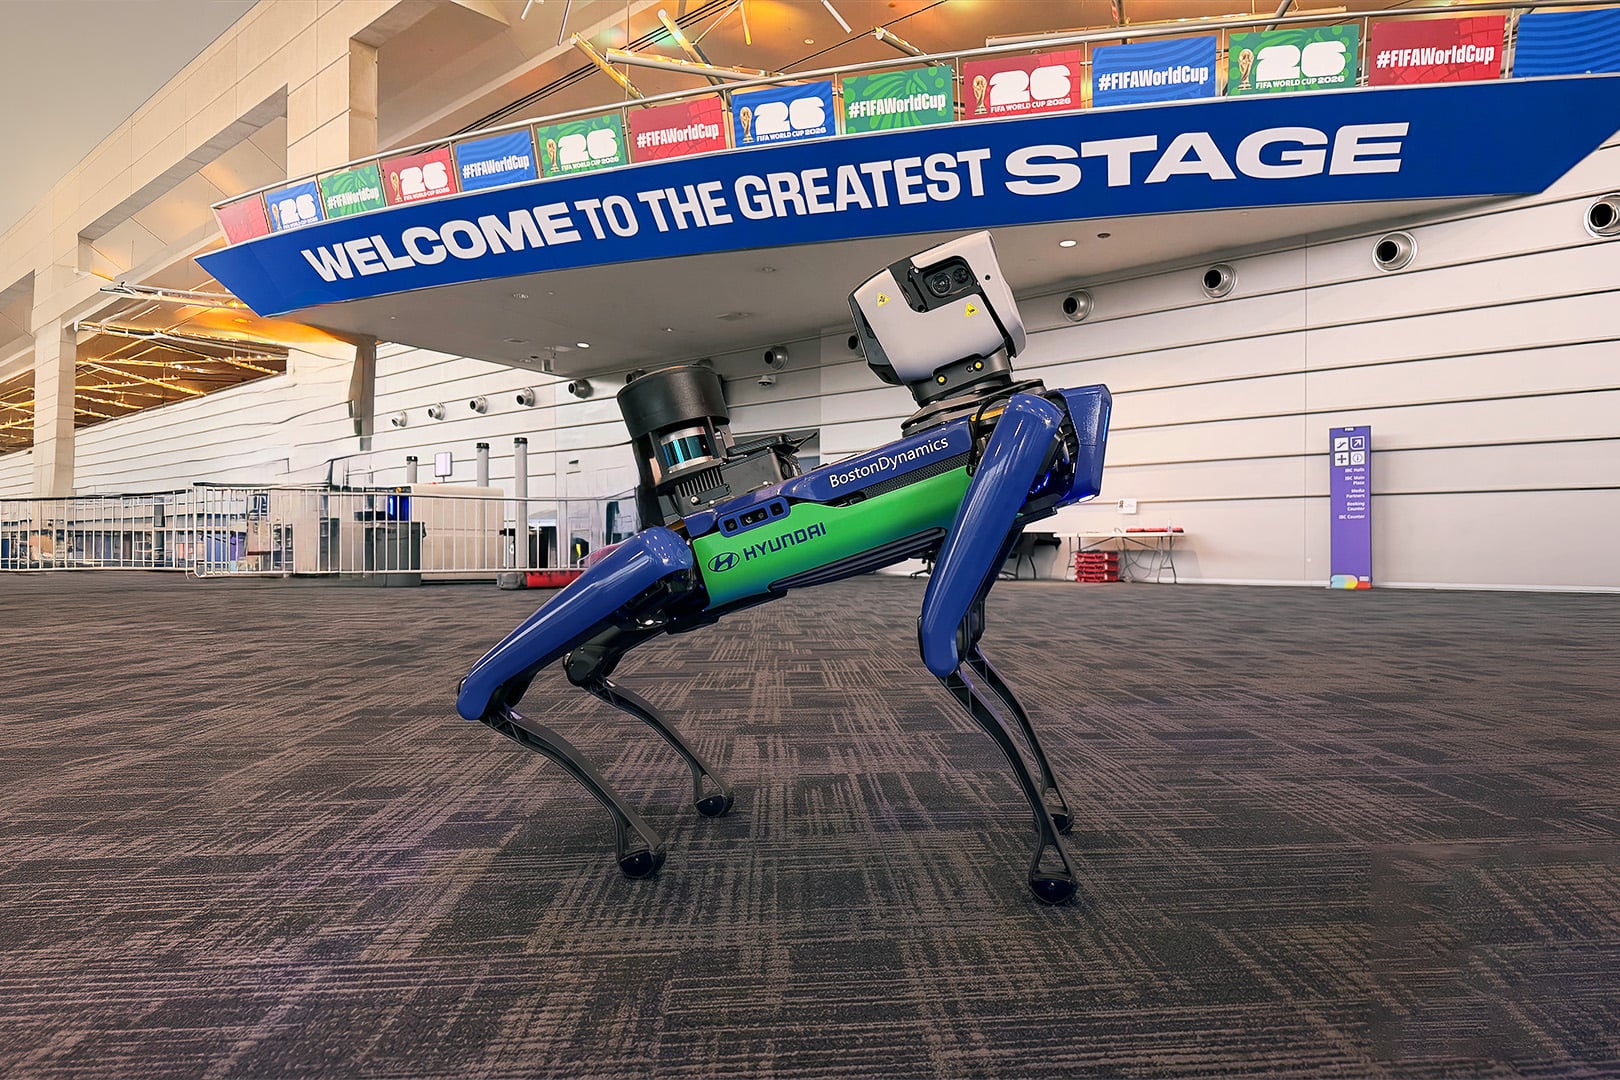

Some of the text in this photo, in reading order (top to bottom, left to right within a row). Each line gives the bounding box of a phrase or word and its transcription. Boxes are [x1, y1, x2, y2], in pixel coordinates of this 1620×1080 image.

[1256, 40, 1347, 81] 26
[1376, 44, 1495, 69] #FIFAWorldCup
[990, 64, 1071, 106] 26
[1098, 65, 1209, 91] #FIFAWorldCup
[1255, 74, 1346, 89] FIFA WORLD CUP 2026
[754, 96, 826, 135] 26
[848, 93, 946, 119] #FIFAWorldCup
[990, 97, 1072, 113] FIFA WORLD CUP 2026
[558, 128, 618, 164] 26
[636, 123, 719, 148] #FIFAWorldCup
[756, 127, 827, 142] FIFA WORLD CUP 2026
[400, 161, 448, 195] 26
[462, 155, 530, 179] #FIFAWorldCup
[279, 193, 316, 226] 26
[301, 121, 1410, 282] WELCOME TO THE GREATEST STAGE
[327, 186, 380, 209] #FIFAWorldCup
[829, 436, 949, 489] BostonDynamics
[743, 522, 827, 561] HYUNDAI
